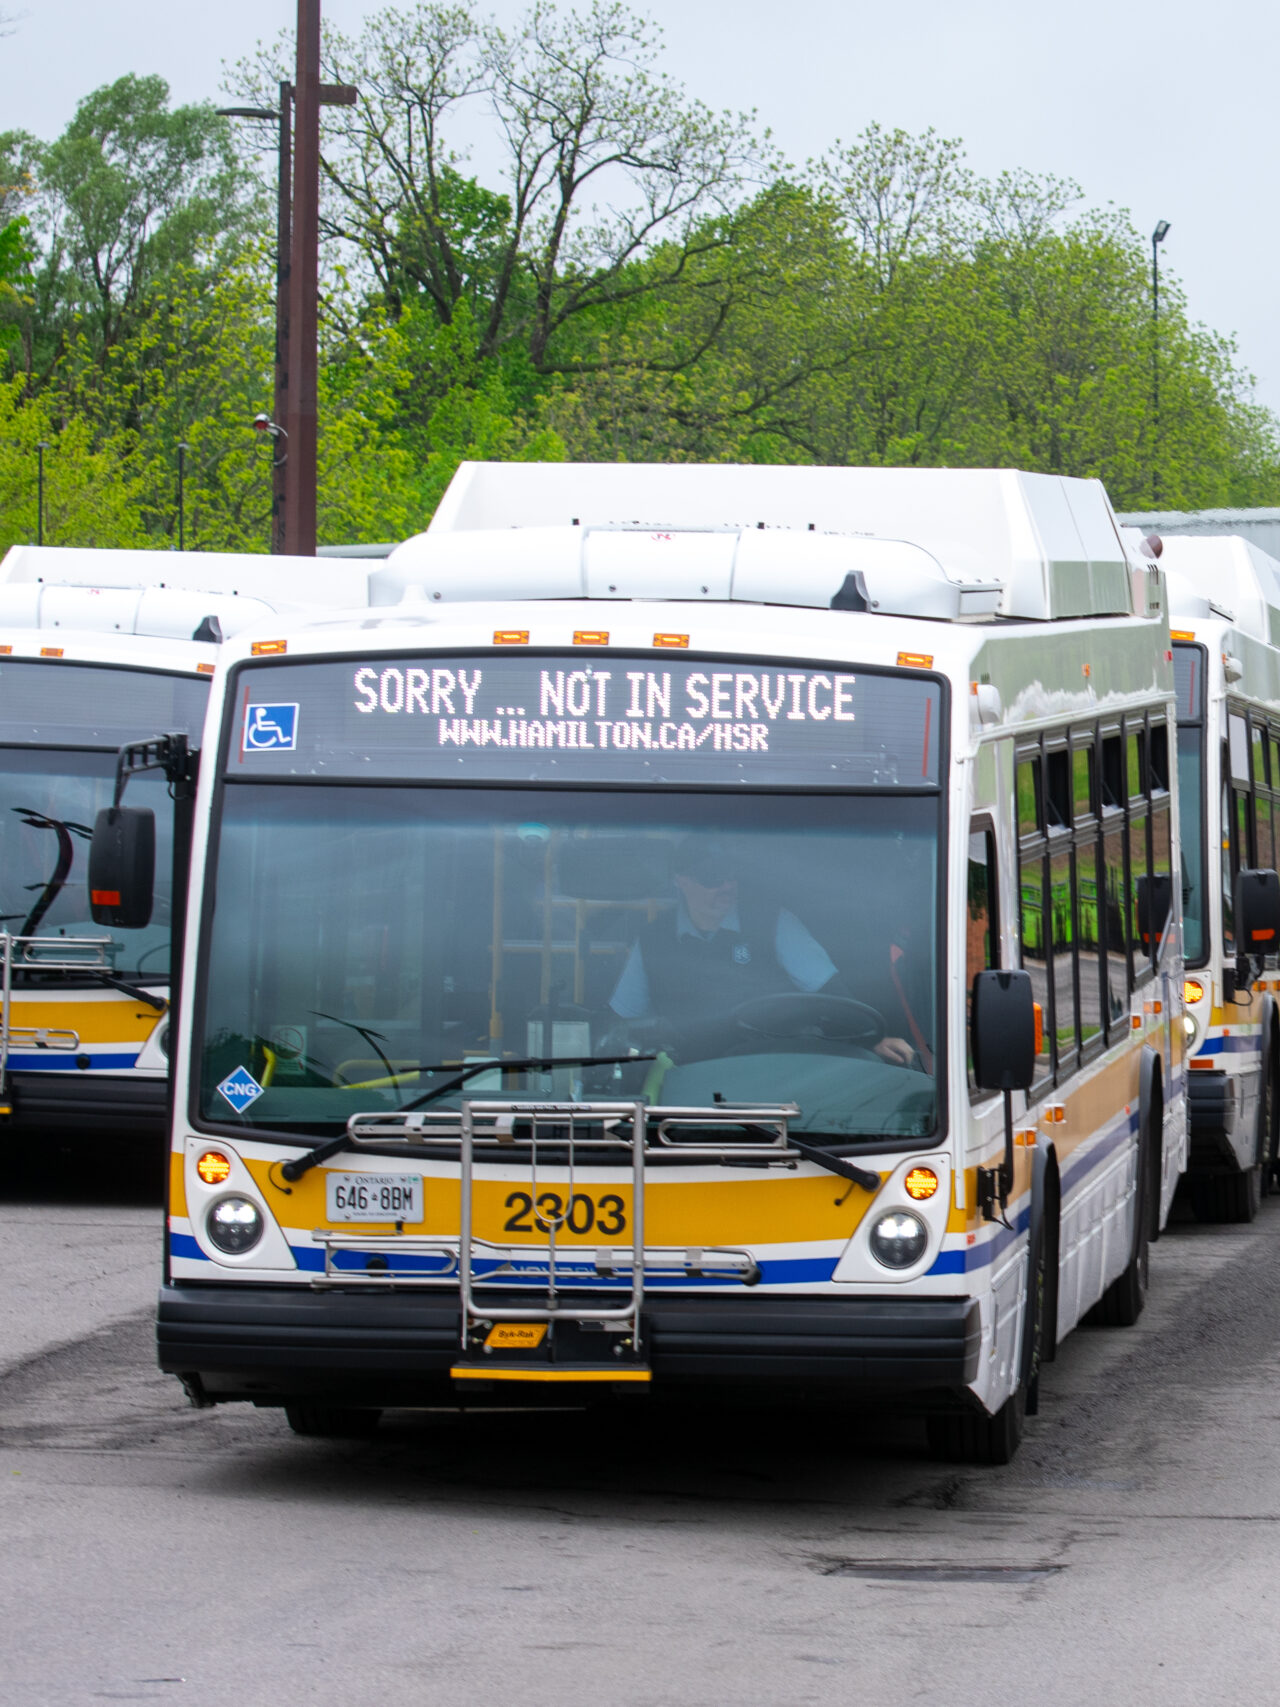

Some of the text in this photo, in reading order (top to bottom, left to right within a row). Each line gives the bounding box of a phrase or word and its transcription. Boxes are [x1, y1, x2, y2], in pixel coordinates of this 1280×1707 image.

[353, 667, 483, 715] SORRY
[540, 669, 612, 717] NOT
[626, 672, 672, 719] IN
[685, 672, 856, 722] SERVICE
[438, 718, 770, 751] WWW.HAMILTON.CA/HSR
[222, 1082, 257, 1096] CNG
[355, 1175, 394, 1185] ONTARIO
[504, 1191, 626, 1236] 2303
